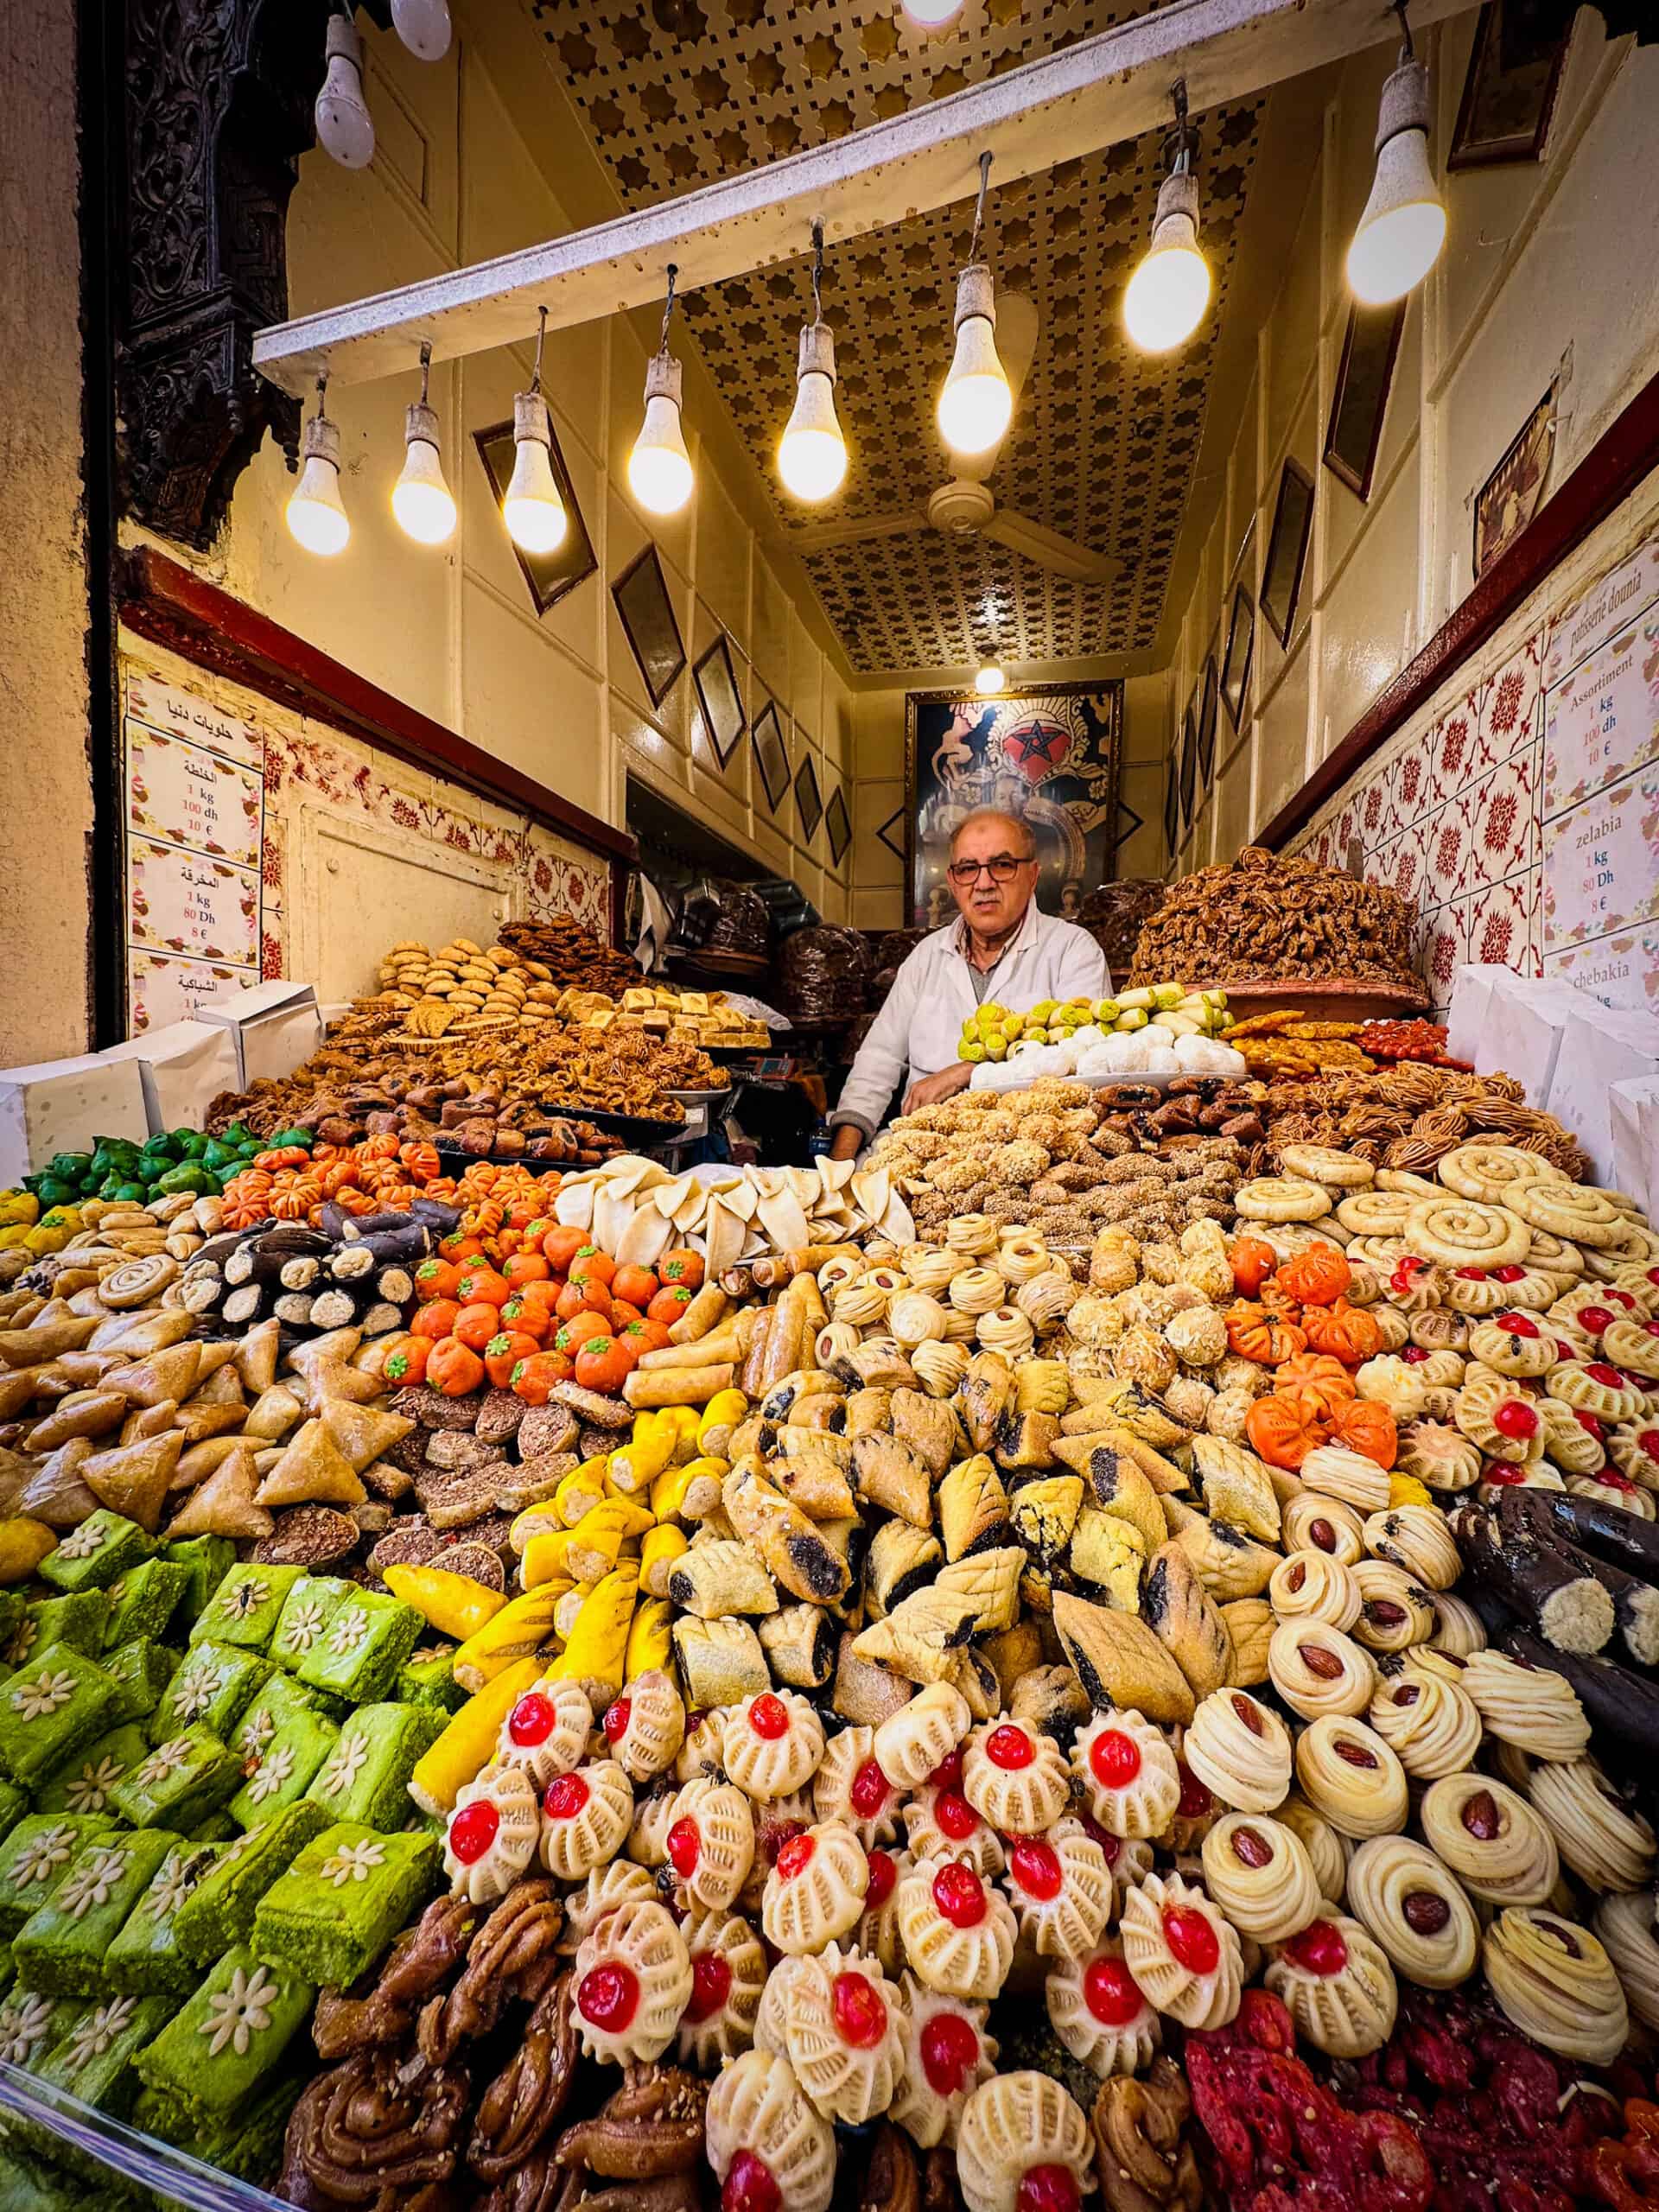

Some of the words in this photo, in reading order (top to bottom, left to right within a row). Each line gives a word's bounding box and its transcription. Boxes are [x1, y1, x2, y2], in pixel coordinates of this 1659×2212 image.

[1609, 568, 1642, 613] dounia
[1569, 655, 1632, 712] Assortiment
[167, 699, 189, 721] دنيا
[1600, 696, 1613, 712] kg
[194, 715, 233, 741] حلويات
[1584, 726, 1600, 746] 100
[1602, 715, 1616, 733] dh
[1589, 748, 1599, 765] 10
[1604, 741, 1611, 755] €
[184, 760, 217, 784] الخلطة
[200, 788, 213, 804] kg
[181, 799, 201, 814] 100
[205, 807, 218, 821] dh
[188, 819, 200, 831] 10
[207, 824, 213, 836] €
[1576, 816, 1622, 849] zelabia
[1594, 850, 1608, 866] kg
[181, 867, 219, 888] المخرقة
[1583, 878, 1594, 893] 80
[1598, 869, 1613, 887] Dh
[197, 893, 210, 908] kg
[1592, 899, 1598, 913] 8
[1600, 896, 1607, 910] €
[184, 907, 196, 919] 80
[200, 912, 215, 924] Dh
[192, 927, 198, 937] 8
[200, 929, 207, 939] €
[178, 975, 218, 993] الشباكية
[1573, 961, 1630, 988] chebakia
